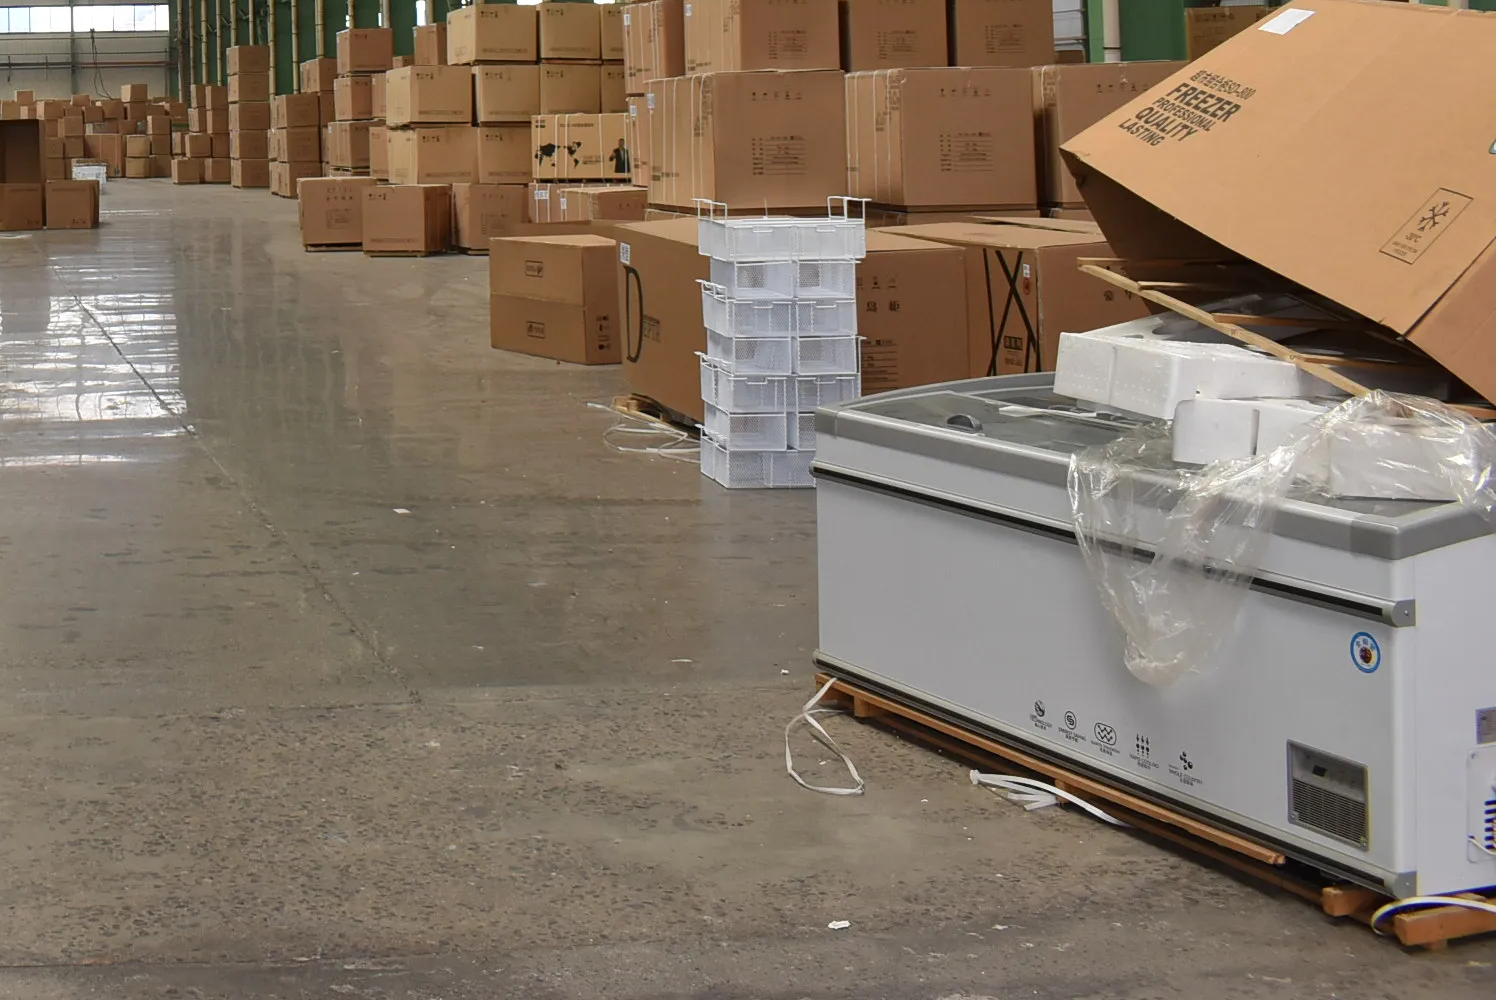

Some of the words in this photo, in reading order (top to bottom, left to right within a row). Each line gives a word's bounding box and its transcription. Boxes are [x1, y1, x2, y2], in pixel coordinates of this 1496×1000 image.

[1152, 97, 1216, 131] PROFESSIONAL
[1166, 82, 1242, 122] FREEZER
[1118, 118, 1166, 146] LASTING
[1135, 106, 1198, 141] QUALITY
